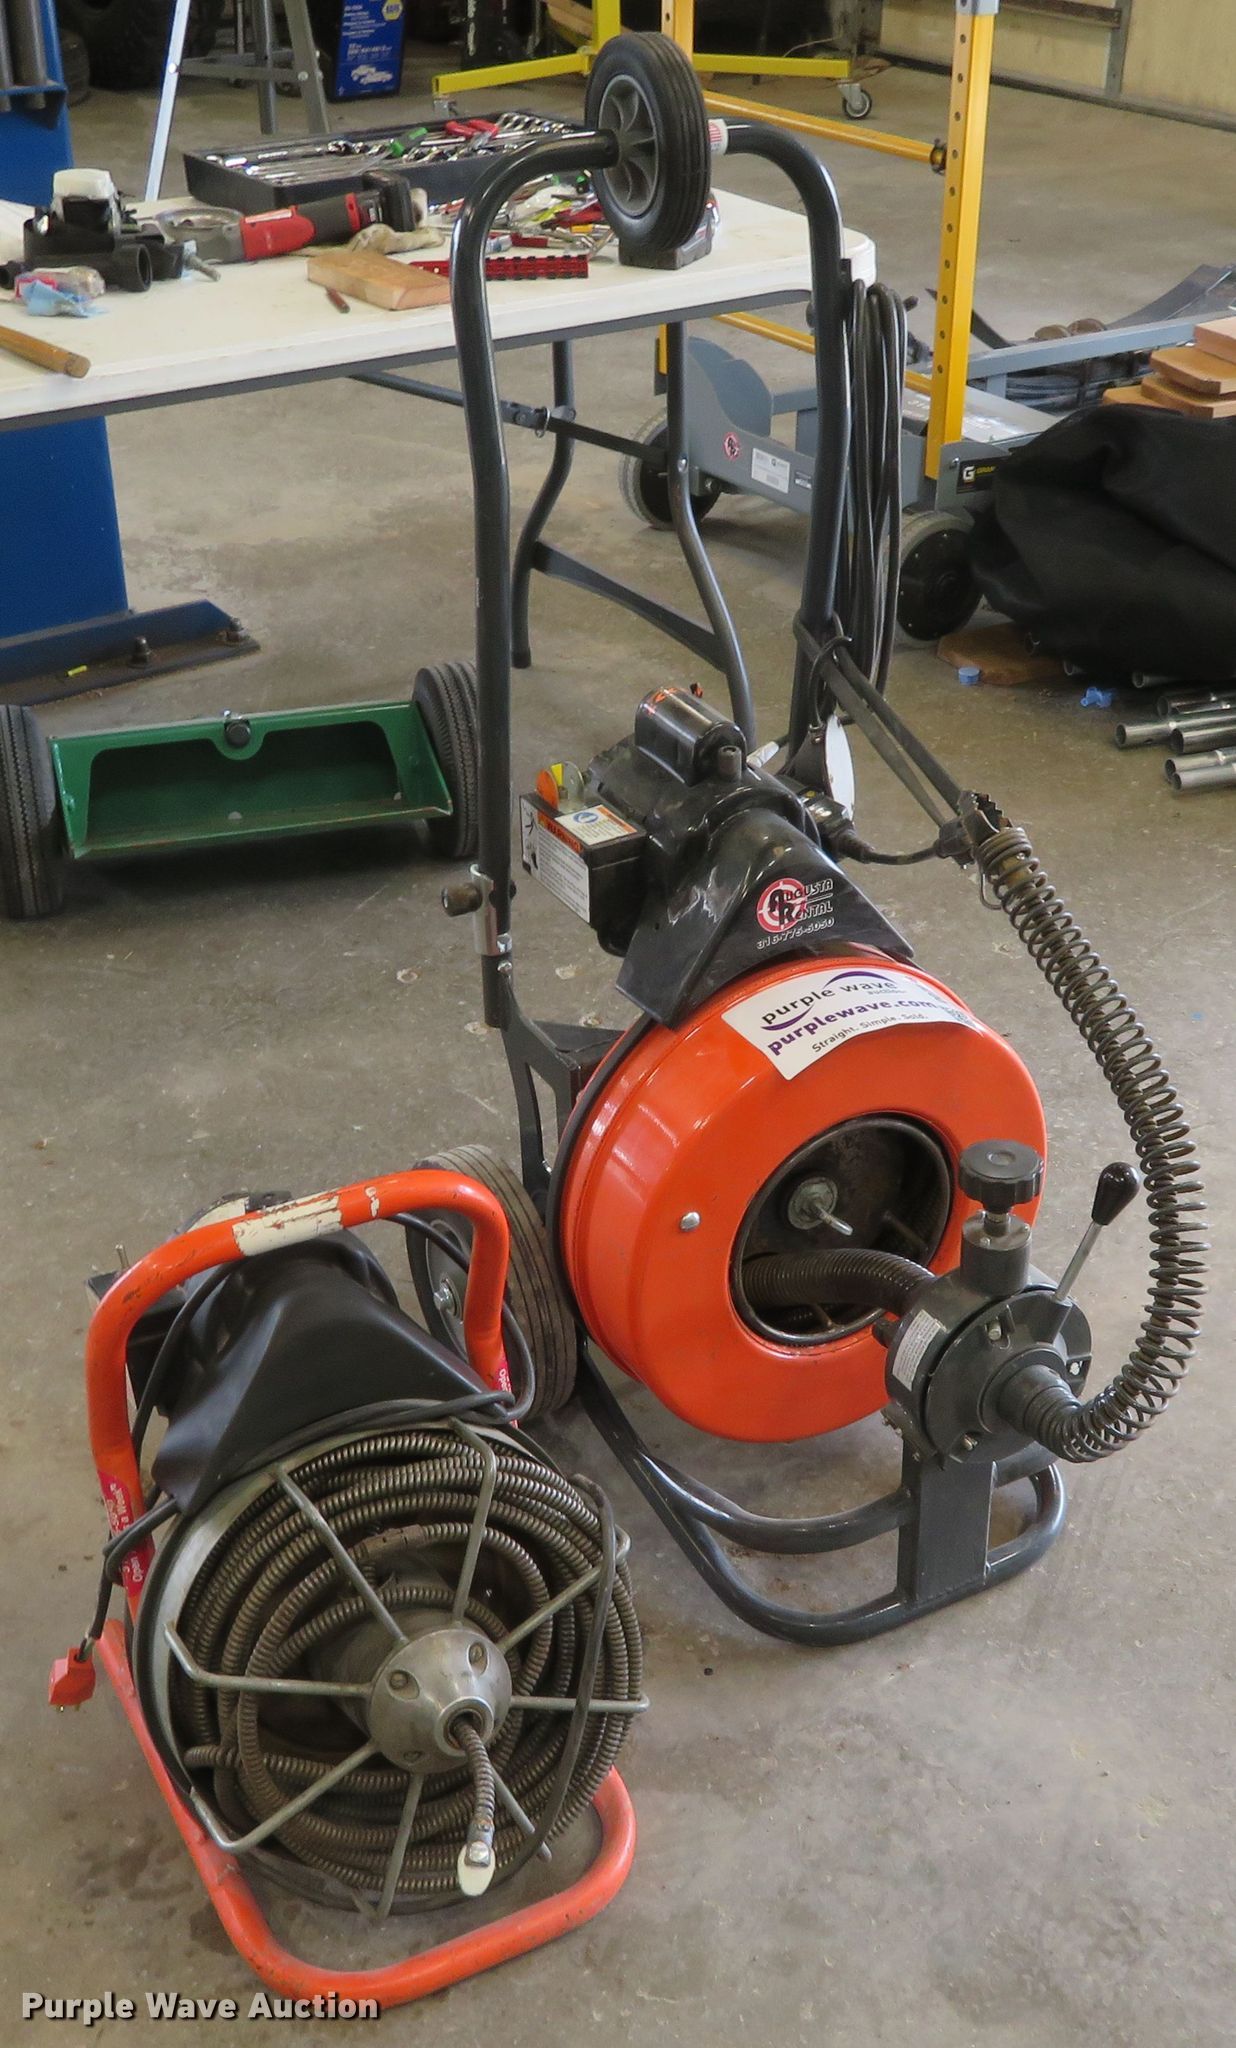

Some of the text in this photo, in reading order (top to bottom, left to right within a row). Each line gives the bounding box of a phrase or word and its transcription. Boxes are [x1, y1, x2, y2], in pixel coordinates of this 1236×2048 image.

[762, 981, 897, 1024] purple wave
[768, 999, 936, 1056] purplewave.com
[812, 1027, 860, 1053] Straight.
